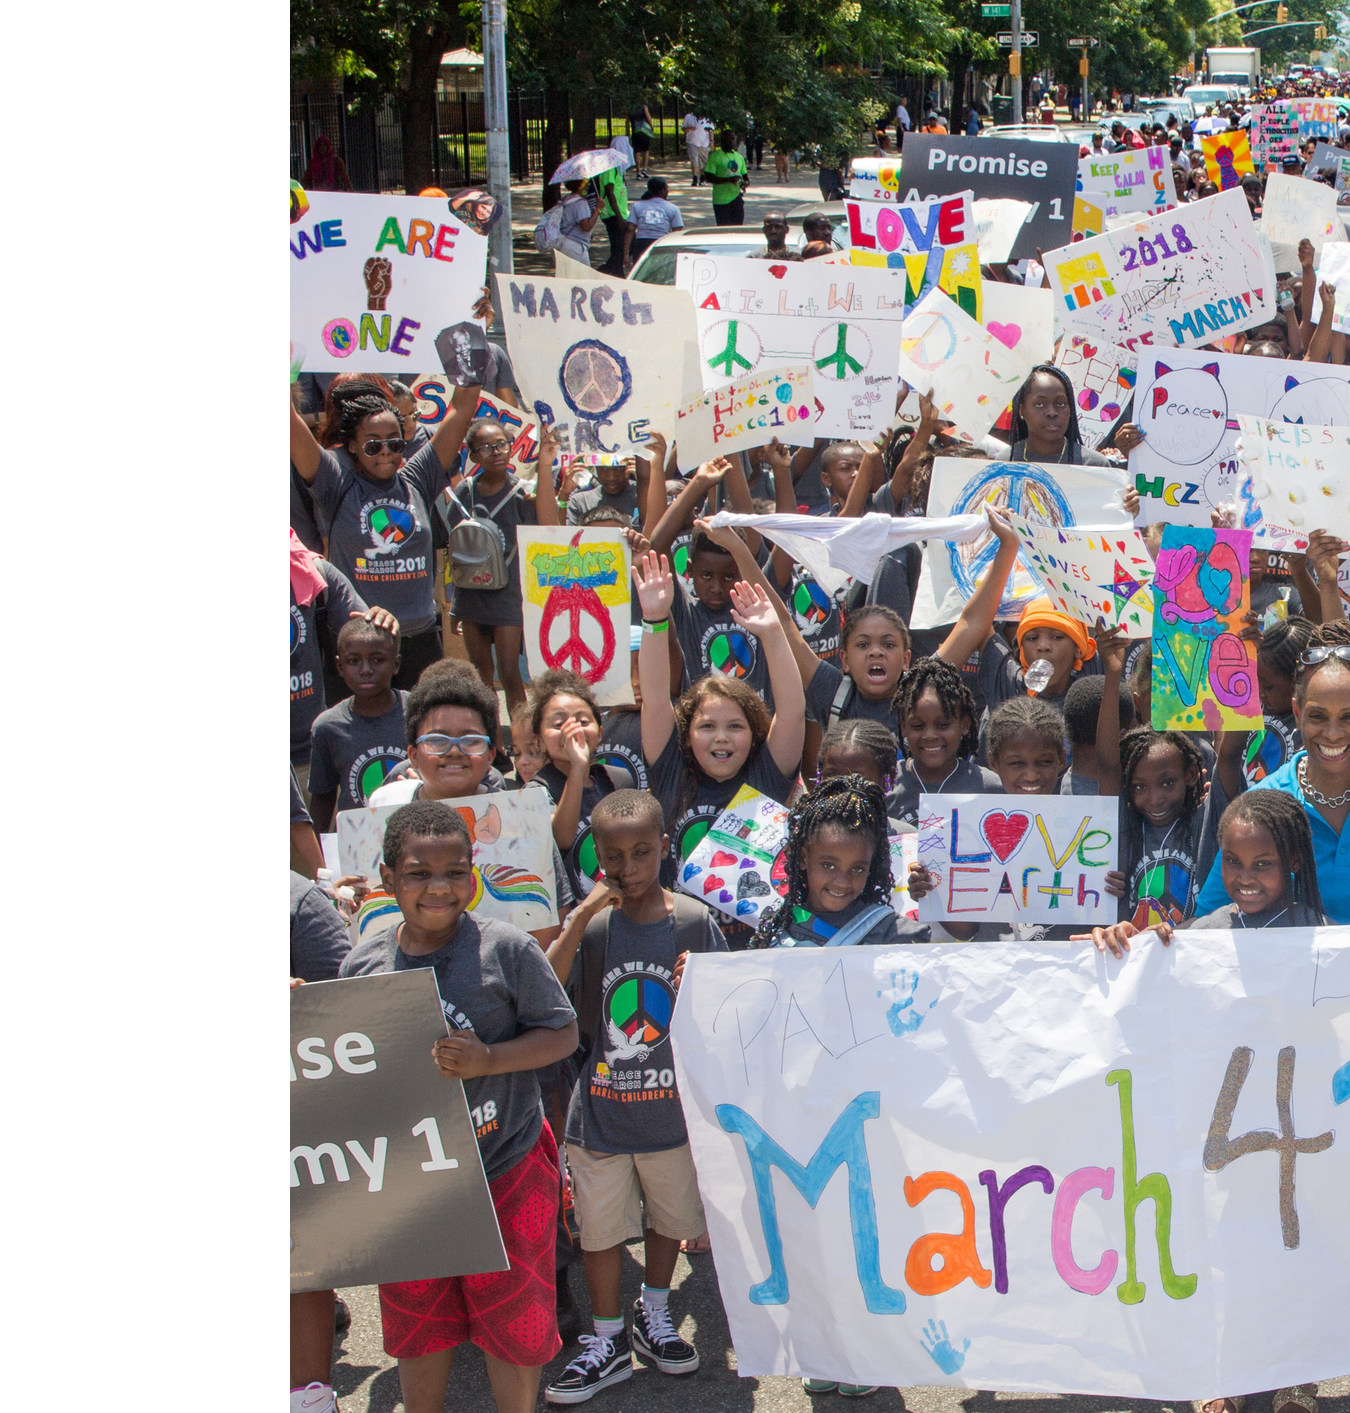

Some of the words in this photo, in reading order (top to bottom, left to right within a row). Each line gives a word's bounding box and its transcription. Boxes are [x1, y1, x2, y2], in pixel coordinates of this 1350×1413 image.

[1265, 105, 1286, 114] ALL
[1297, 103, 1336, 121] PEACE
[928, 148, 1048, 178] Promise
[1090, 163, 1119, 177] KEEP
[1114, 170, 1145, 188] CALM
[847, 198, 965, 252] LOVE
[290, 219, 347, 260] WE
[375, 216, 460, 263] ARE
[1119, 224, 1193, 272] 2018
[321, 313, 421, 358] ONE
[1152, 387, 1211, 420] Peace
[1136, 473, 1200, 507] HCZ
[396, 556, 426, 573] 2018
[532, 548, 618, 590] PEACE
[355, 574, 379, 582] HARLEM
[290, 670, 314, 693] 018
[367, 746, 385, 757] WE
[612, 744, 632, 755] ARE
[697, 804, 717, 815] WE
[1152, 848, 1170, 859] WE
[624, 960, 644, 974] WE
[646, 962, 672, 980] ARE
[611, 1069, 642, 1082] EACE
[611, 1079, 642, 1090] ARCH
[621, 1088, 674, 1103] CHILDREN'S
[477, 1119, 499, 1139] ZONE
[411, 1116, 460, 1173] 1
[715, 1068, 1198, 1316] March
[1202, 1045, 1336, 1251] 4
